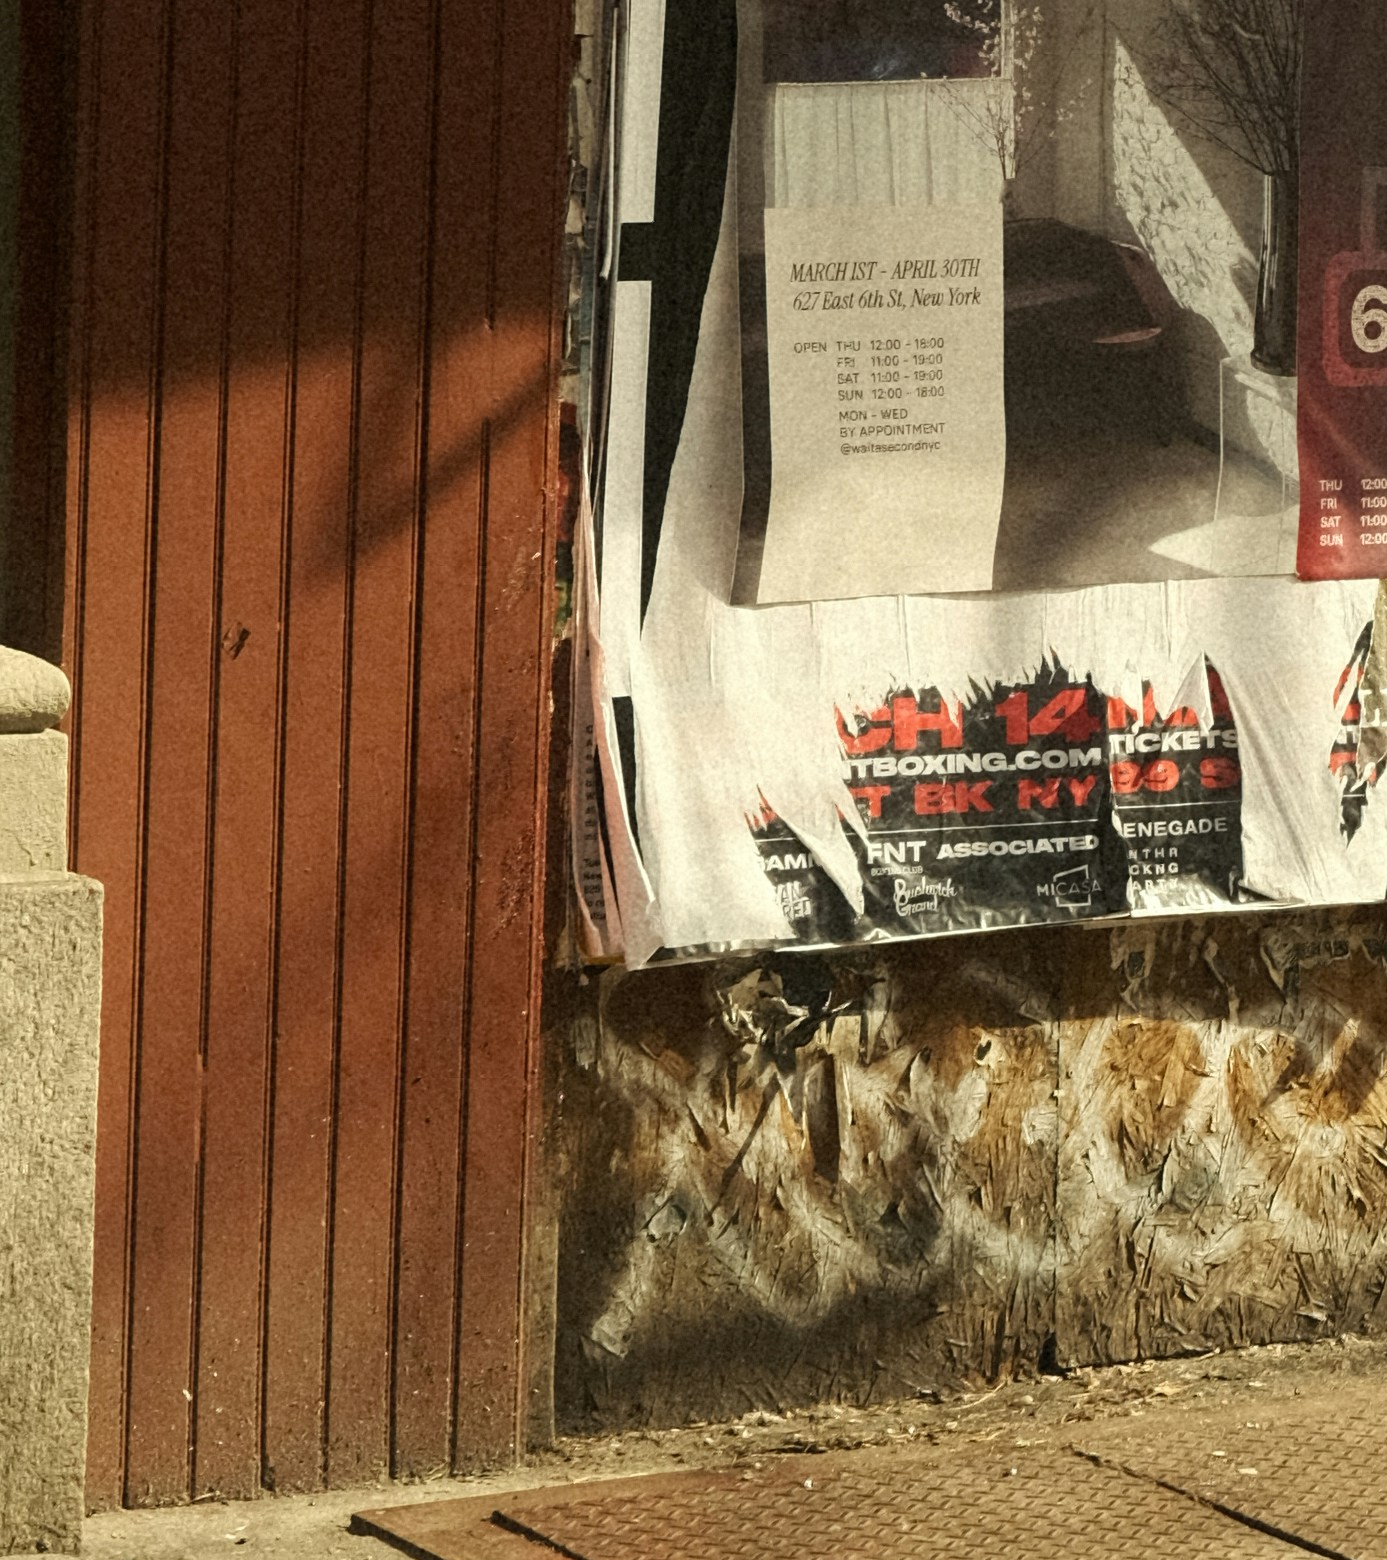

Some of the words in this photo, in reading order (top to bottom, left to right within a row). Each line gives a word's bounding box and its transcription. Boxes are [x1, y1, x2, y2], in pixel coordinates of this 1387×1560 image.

[790, 263, 847, 282] MARCH
[891, 259, 937, 279] APRIL
[941, 258, 981, 278] 30TH
[793, 291, 821, 310] 627
[822, 291, 854, 310] East
[859, 289, 884, 309] 6th
[910, 288, 943, 307] New
[948, 286, 981, 306] York
[794, 342, 827, 353] OPEN
[836, 341, 860, 352] THU
[838, 390, 863, 401] SUN
[839, 411, 867, 422] MON
[881, 409, 908, 419] WED
[840, 427, 856, 438] BY
[860, 423, 945, 437] APPOINTMENT
[1320, 480, 1342, 491] THU
[1321, 498, 1337, 509] FRI
[1321, 516, 1341, 528] SAT
[1320, 534, 1343, 546] SUN
[995, 689, 1100, 745] 14
[1108, 730, 1238, 754] TICKETS
[915, 780, 993, 815] BK
[1018, 776, 1096, 810] NY
[867, 841, 926, 864] FNT
[936, 835, 1099, 860] ASSOCIATED
[1124, 818, 1227, 838] ENEGADE
[894, 877, 958, 902] Bushwick
